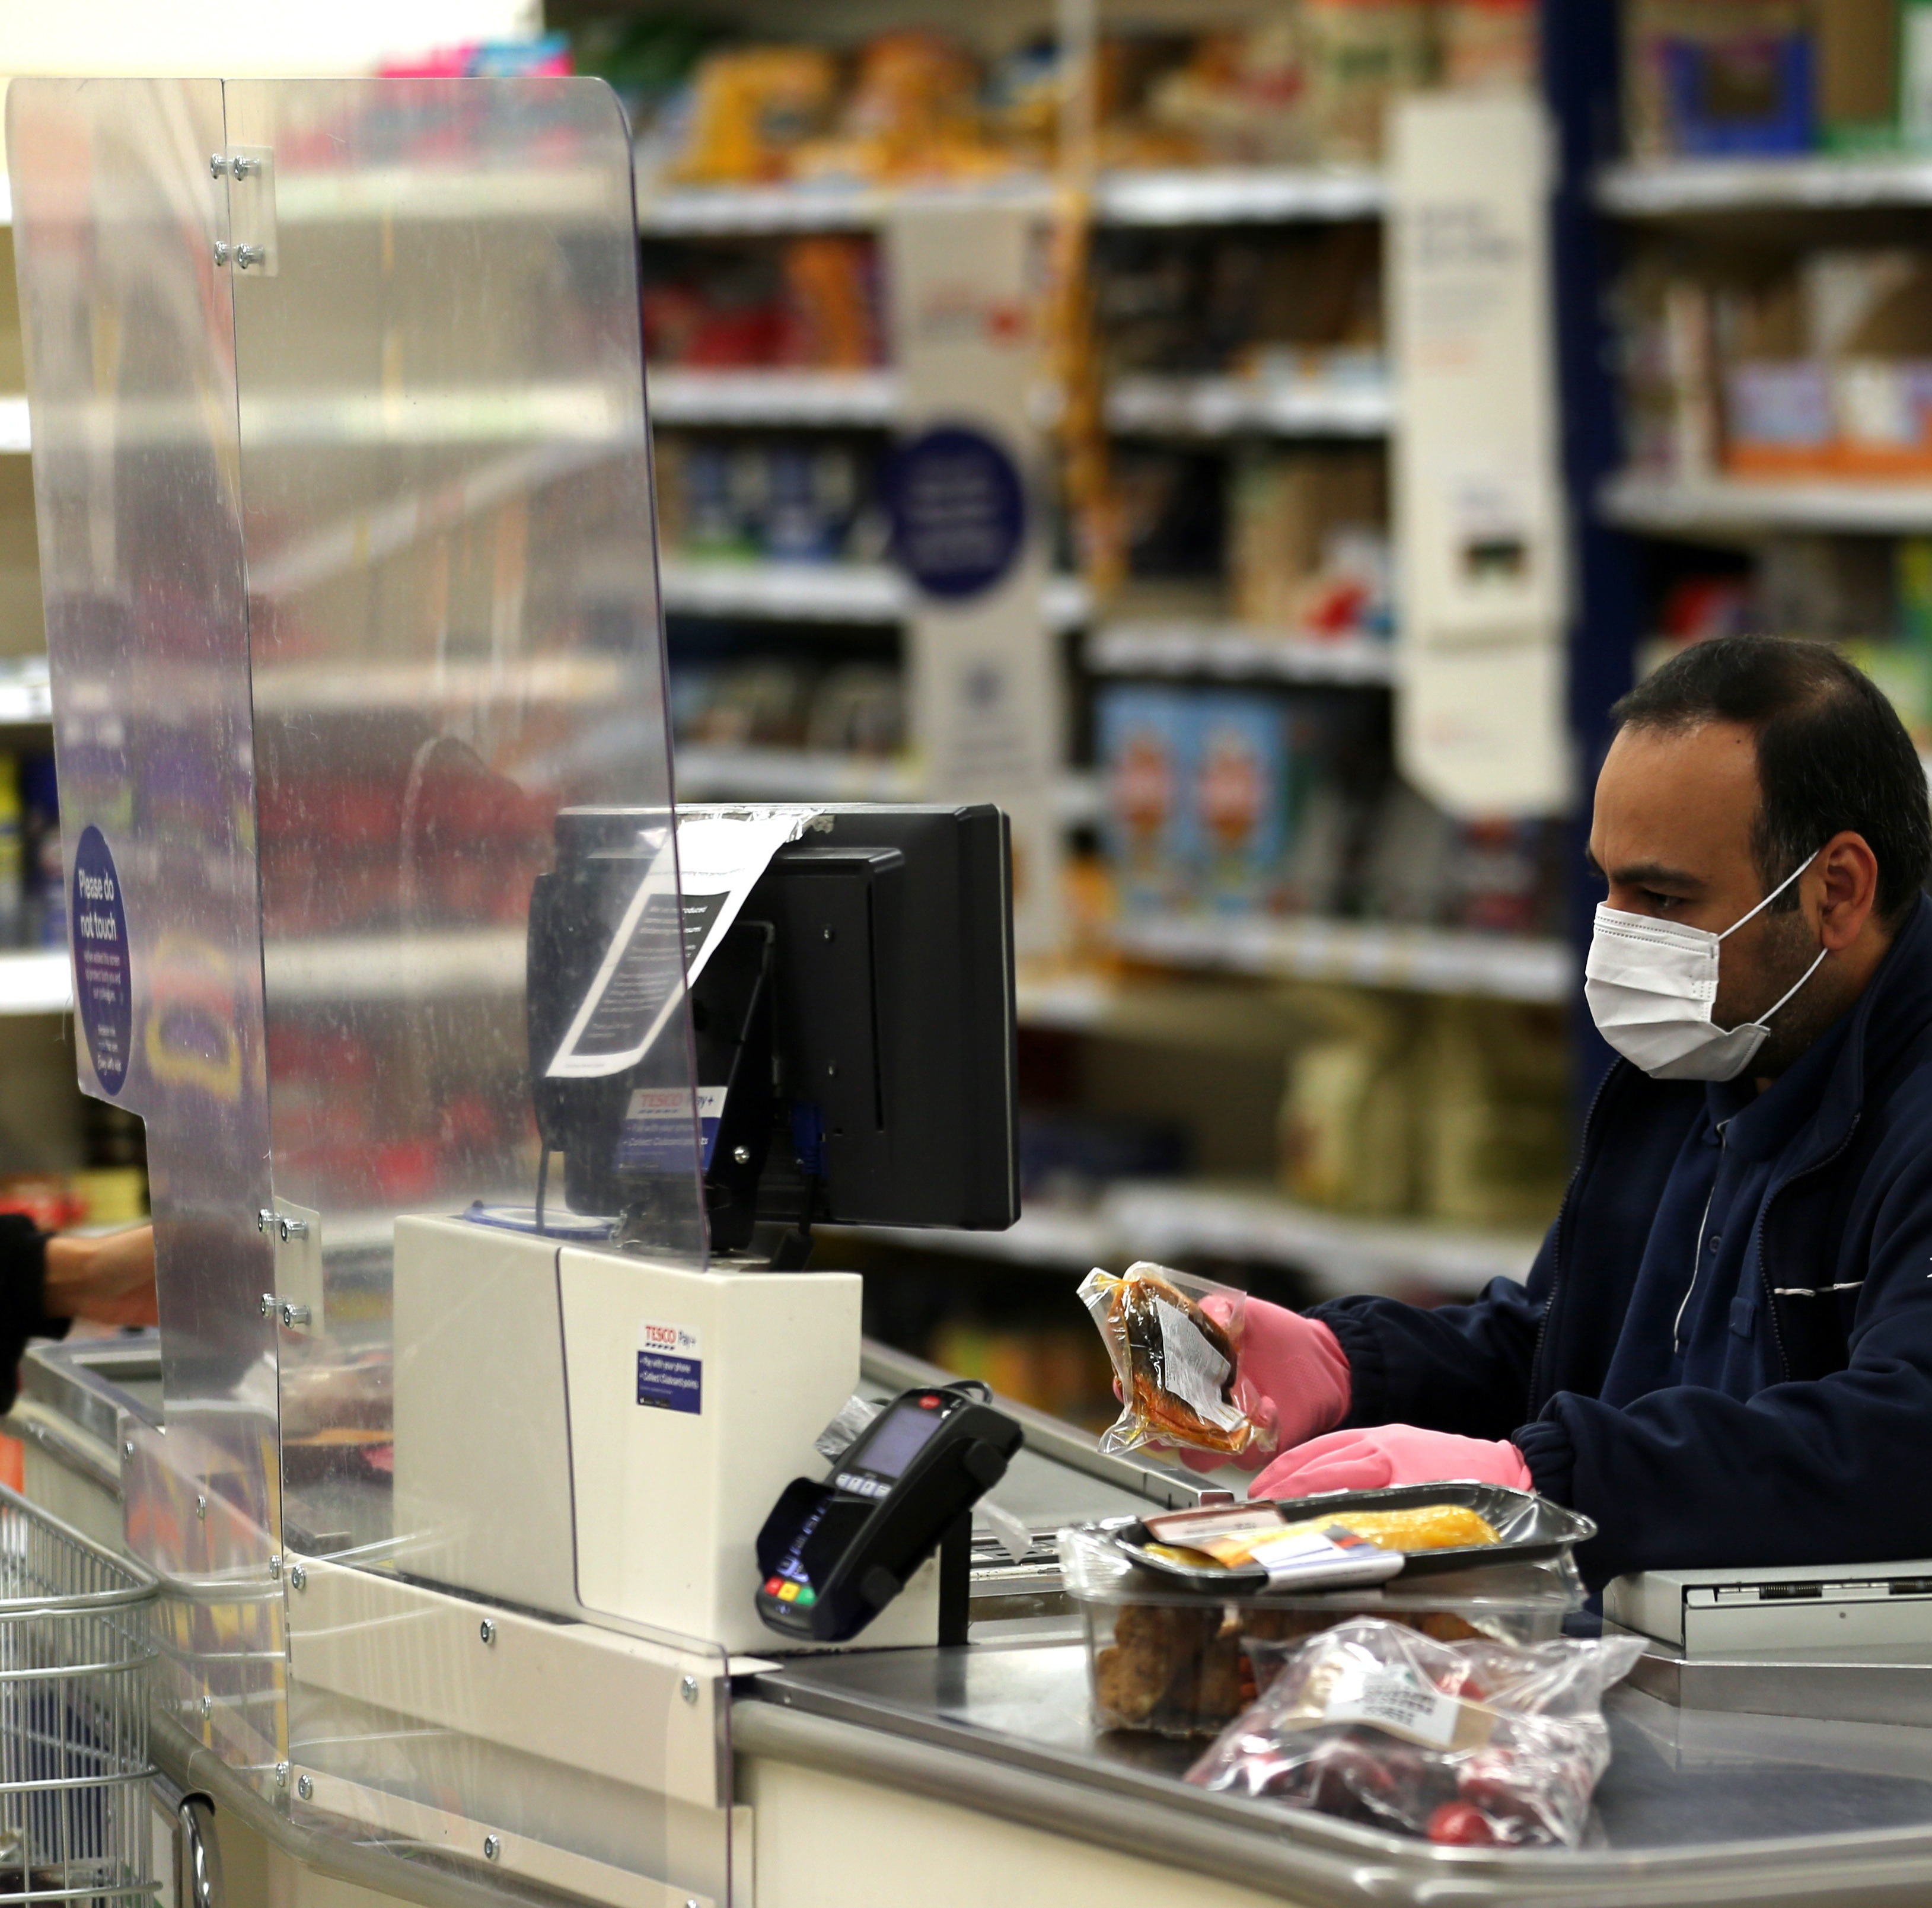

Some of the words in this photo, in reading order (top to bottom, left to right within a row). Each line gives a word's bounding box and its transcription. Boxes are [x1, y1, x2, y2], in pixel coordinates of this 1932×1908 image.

[78, 869, 103, 900] Please
[104, 872, 114, 901] do
[81, 912, 94, 938] not
[94, 911, 117, 941] touch
[642, 1093, 684, 1107] TESCO
[645, 1325, 677, 1343] TESCO
